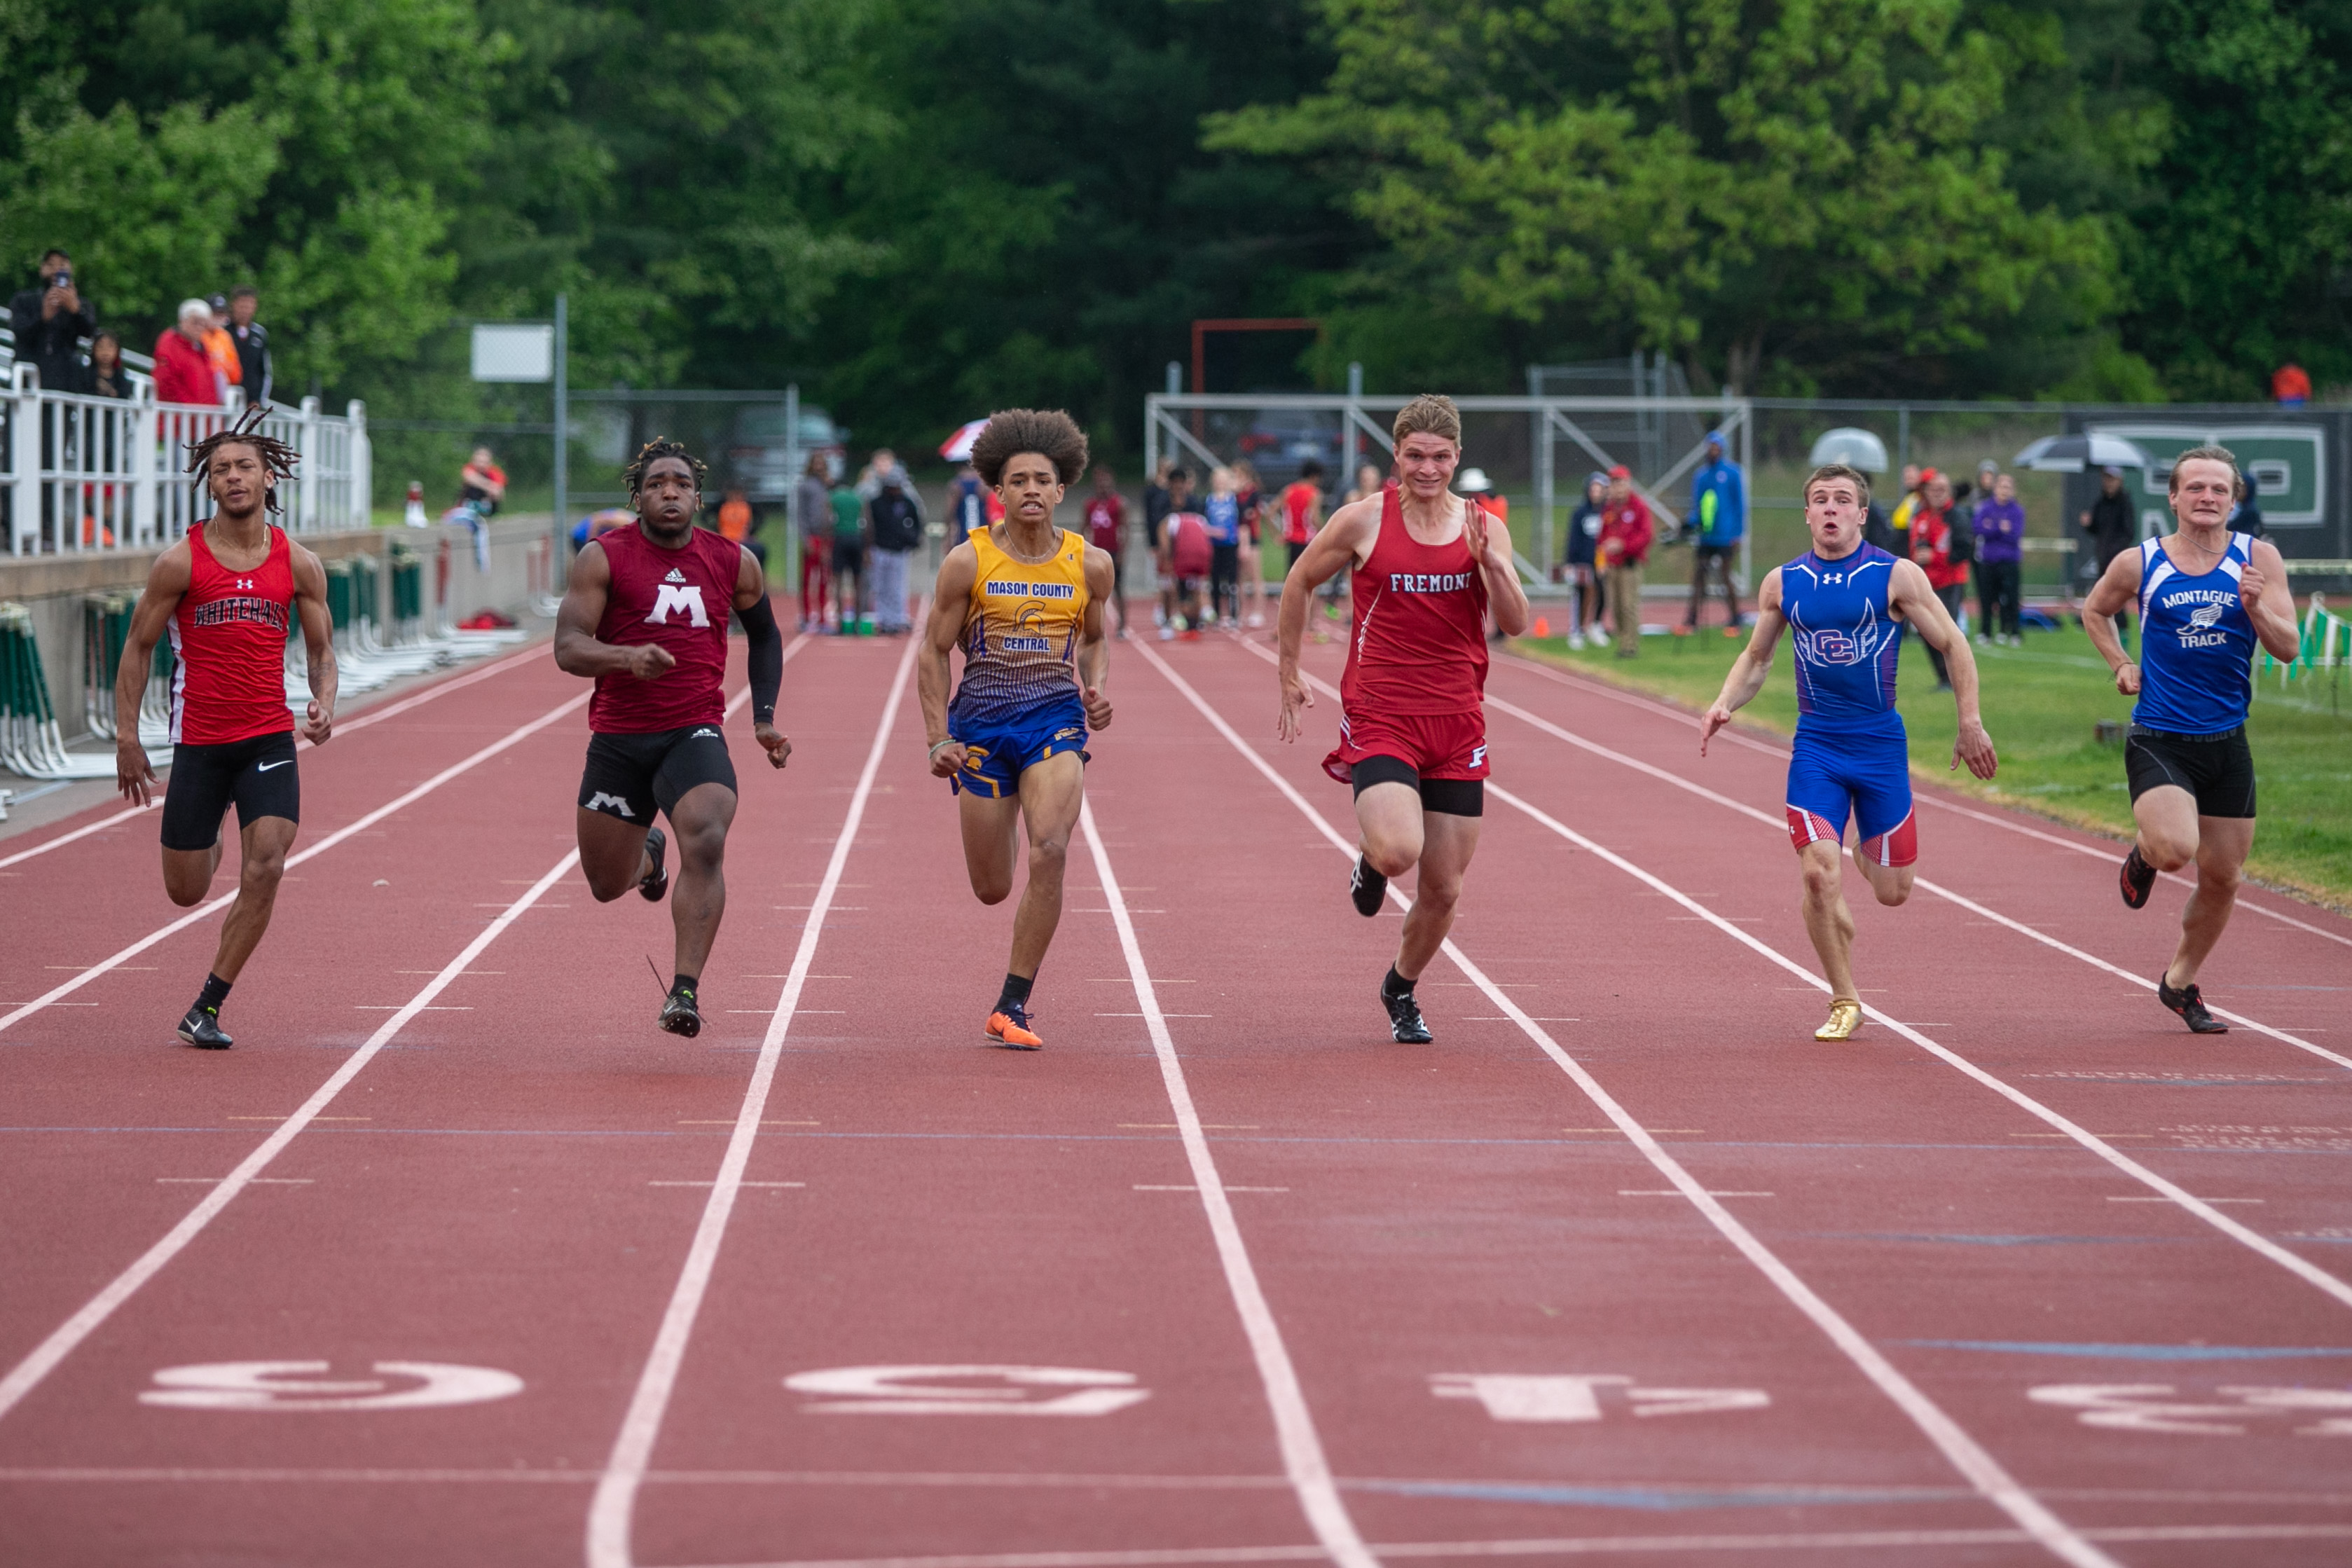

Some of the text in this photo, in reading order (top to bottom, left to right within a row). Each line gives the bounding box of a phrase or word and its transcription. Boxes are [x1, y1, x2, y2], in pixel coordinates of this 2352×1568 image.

[986, 581, 1074, 599] MASON COUNTY
[1390, 572, 1473, 593] FREMONT
[644, 584, 710, 628] M
[2161, 590, 2238, 610] MONTAGUE
[194, 597, 287, 632] WHITEHALL
[1003, 636, 1050, 652] CENTRAL
[2178, 632, 2227, 649] TRACK
